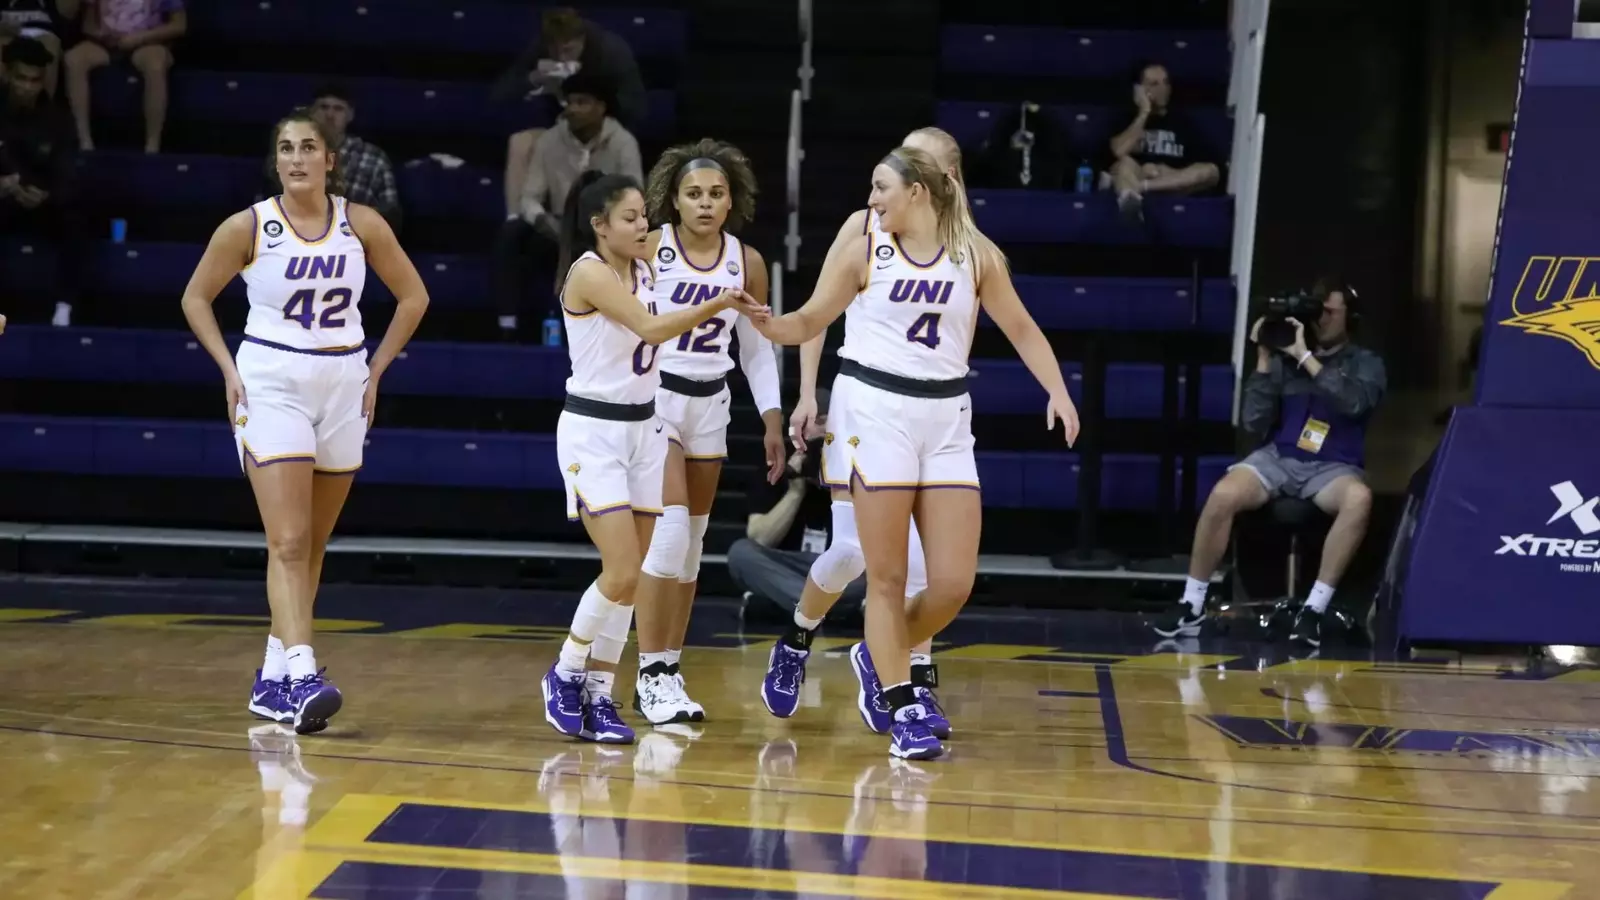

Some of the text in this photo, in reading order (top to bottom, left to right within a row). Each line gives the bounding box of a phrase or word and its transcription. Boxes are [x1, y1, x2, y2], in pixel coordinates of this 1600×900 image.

[284, 254, 347, 280] UNI
[670, 281, 731, 306] UN
[888, 278, 955, 305] UNI
[282, 287, 353, 330] 42
[676, 317, 726, 353] 12
[906, 312, 942, 350] 4
[632, 340, 660, 376] 0
[1494, 533, 1600, 558] XTRE
[1560, 563, 1585, 572] POWERED
[1585, 564, 1592, 572] BY
